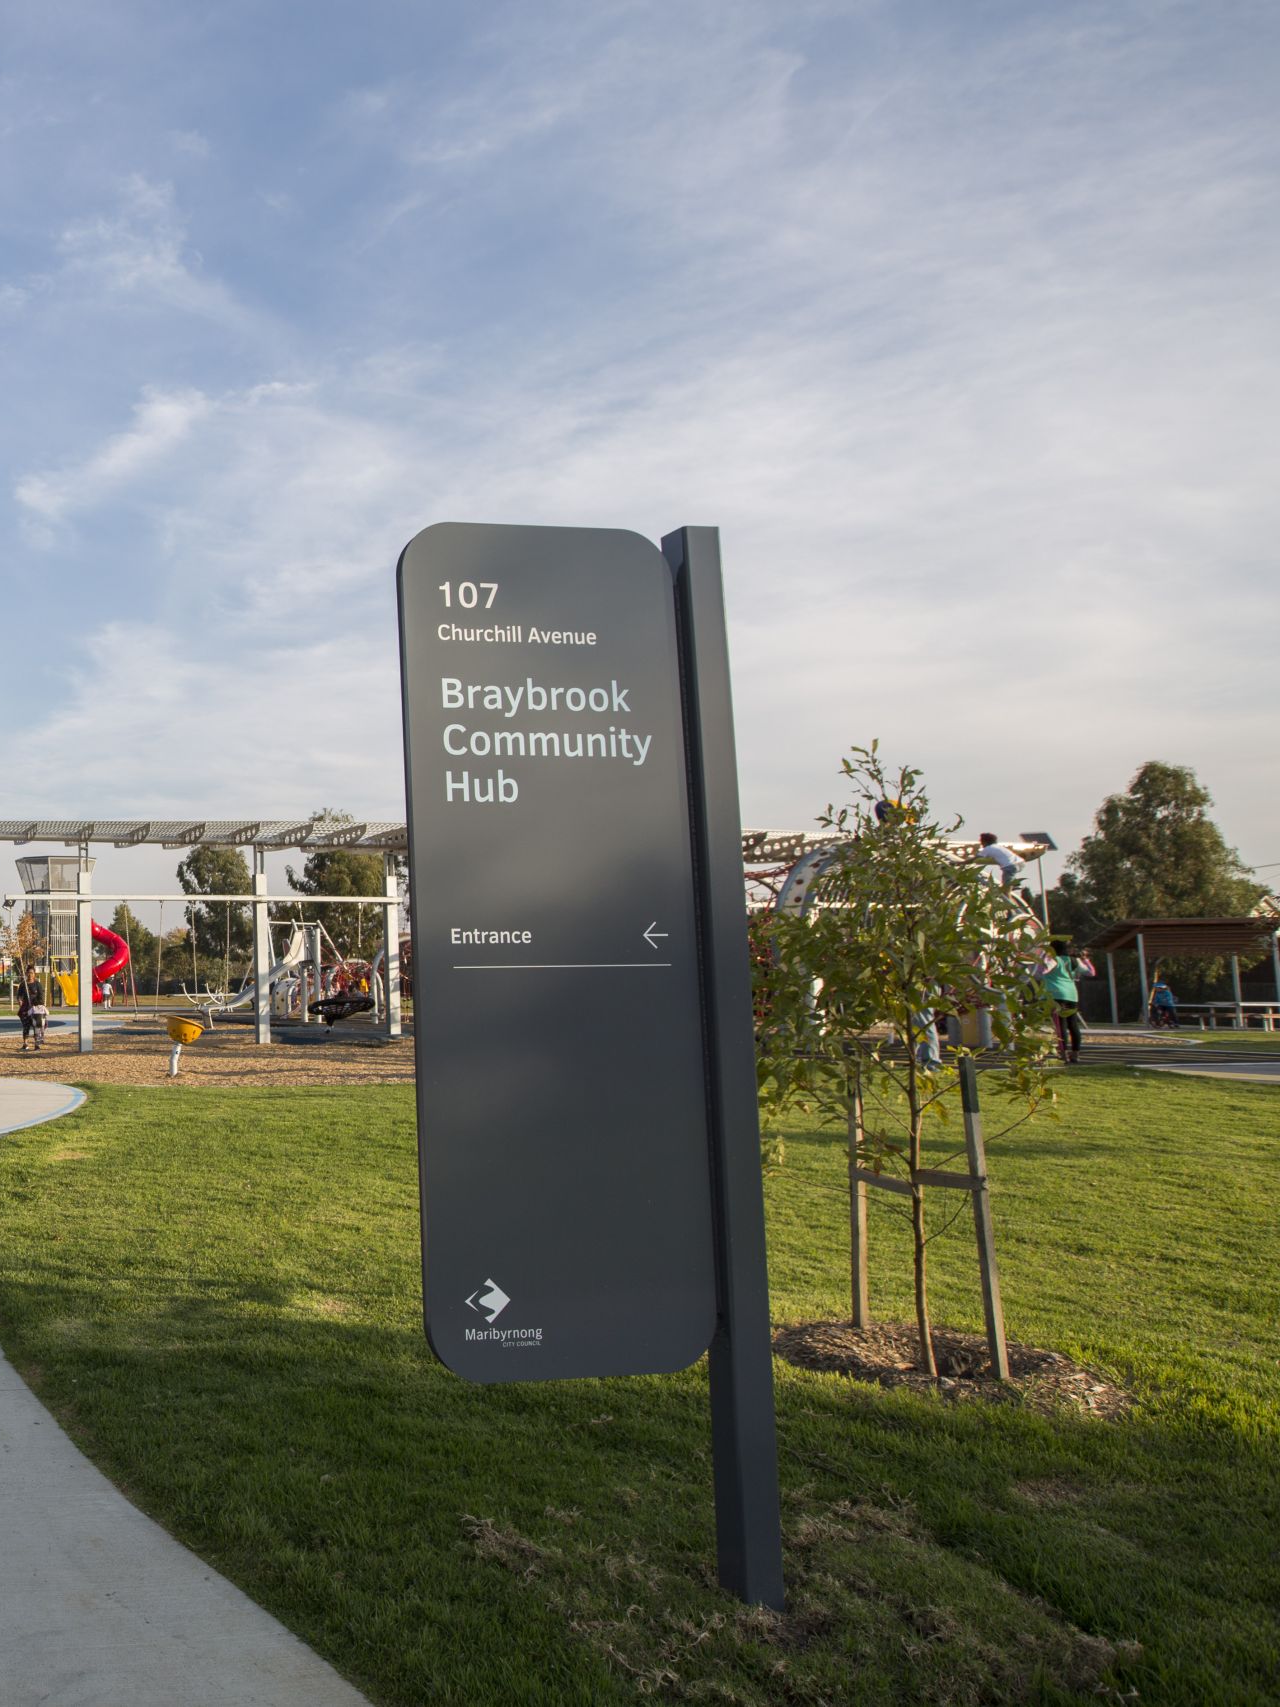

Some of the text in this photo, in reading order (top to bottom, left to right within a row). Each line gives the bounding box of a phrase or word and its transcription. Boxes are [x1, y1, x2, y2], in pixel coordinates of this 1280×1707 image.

[439, 582, 499, 609] 107
[438, 624, 597, 645] Churchill Avenue
[441, 678, 631, 717] Braybrook
[443, 724, 652, 766] Community
[445, 769, 519, 803] Hub
[451, 928, 532, 944] Entrance
[465, 1328, 543, 1342] Maribyrnong
